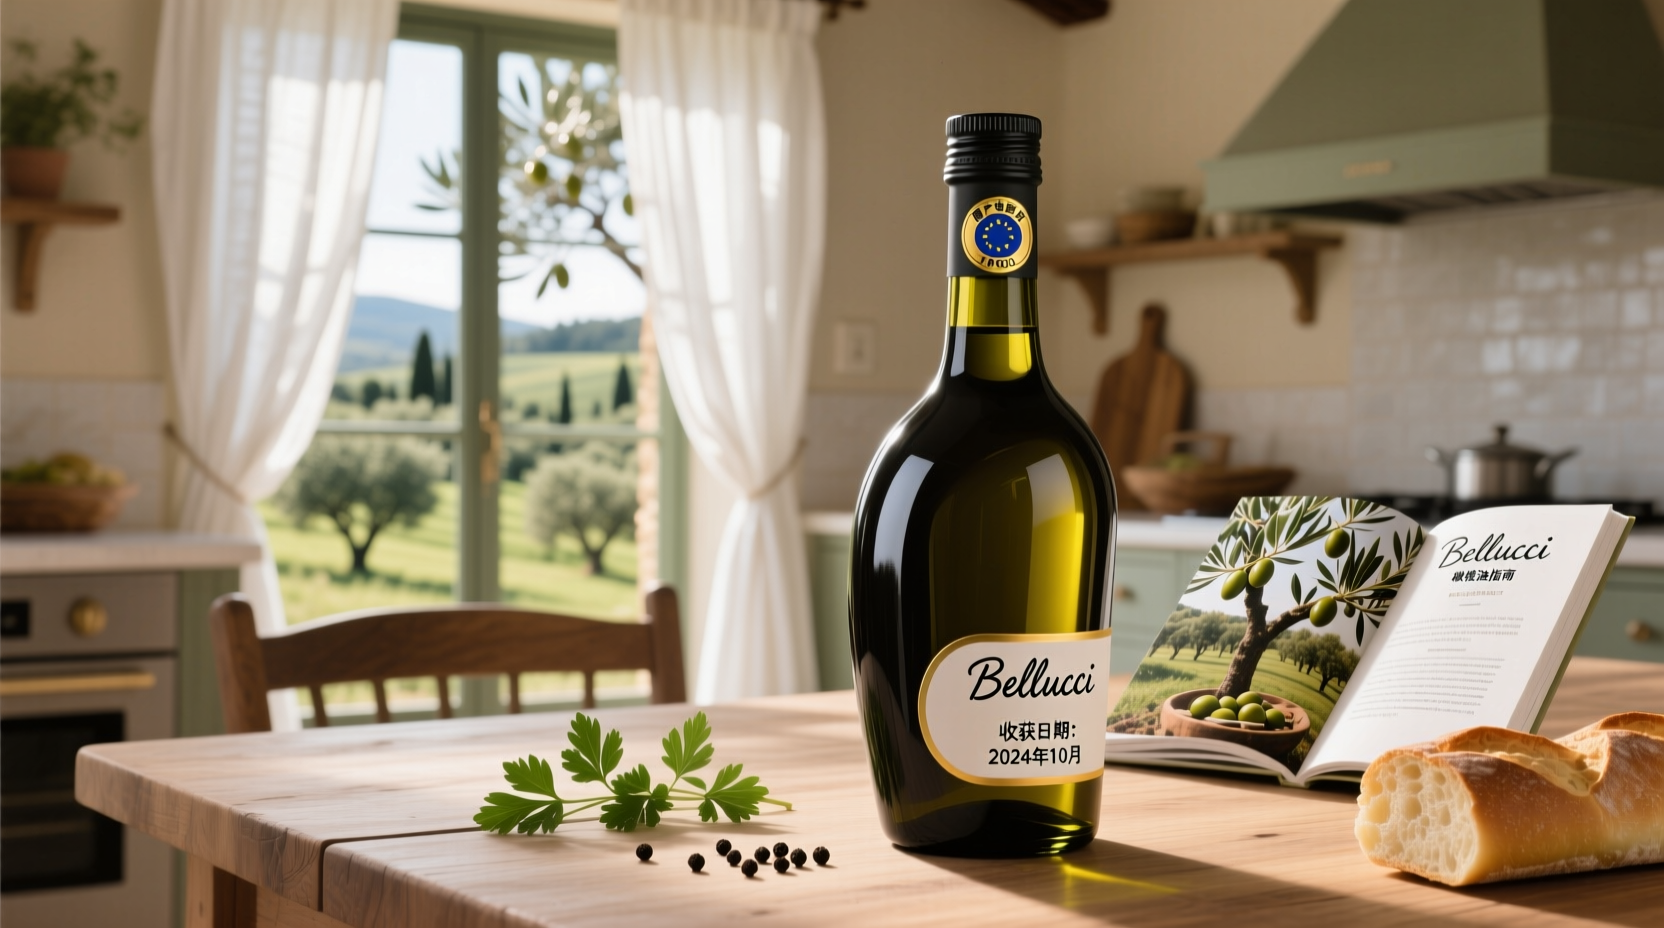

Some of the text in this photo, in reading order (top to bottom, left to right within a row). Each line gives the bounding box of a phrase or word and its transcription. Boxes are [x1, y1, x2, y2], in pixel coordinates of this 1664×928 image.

[1438, 533, 1553, 568] Bellucci
[968, 657, 1095, 701] Bellucci
[988, 745, 1081, 766] 2024年10月
